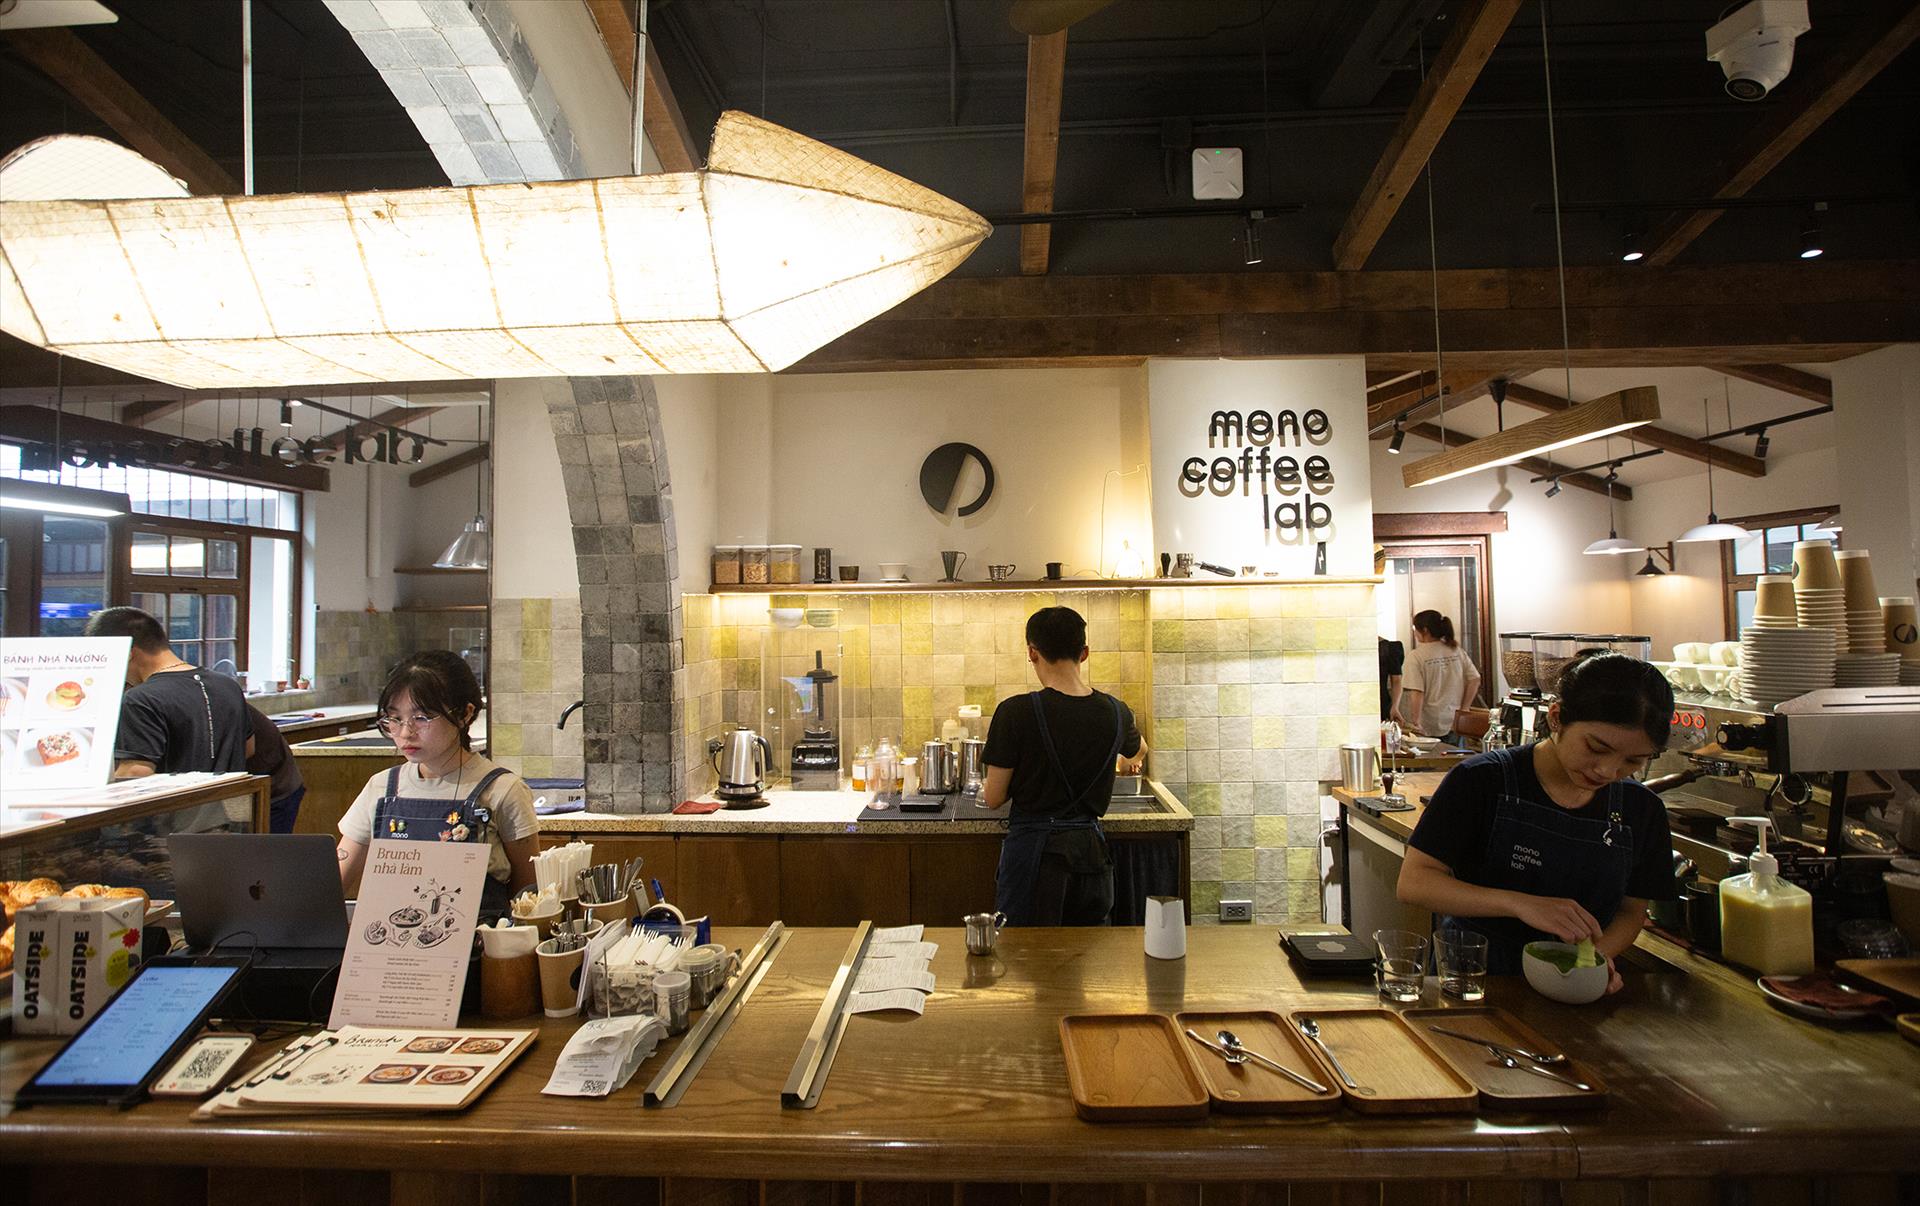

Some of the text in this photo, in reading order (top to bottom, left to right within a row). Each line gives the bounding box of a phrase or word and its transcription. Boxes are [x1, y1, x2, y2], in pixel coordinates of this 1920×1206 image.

[1210, 409, 1329, 437] mono
[345, 424, 425, 465] lab
[1182, 446, 1331, 483] coffee
[1262, 493, 1333, 530] lab
[376, 847, 421, 861] Brunch
[1512, 853, 1542, 867] coffee
[1513, 845, 1540, 857] mono
[373, 861, 423, 876] nhà làm
[1510, 861, 1525, 871] lab
[23, 930, 45, 1020] OATSIDE
[69, 930, 90, 1020] OATSIDE
